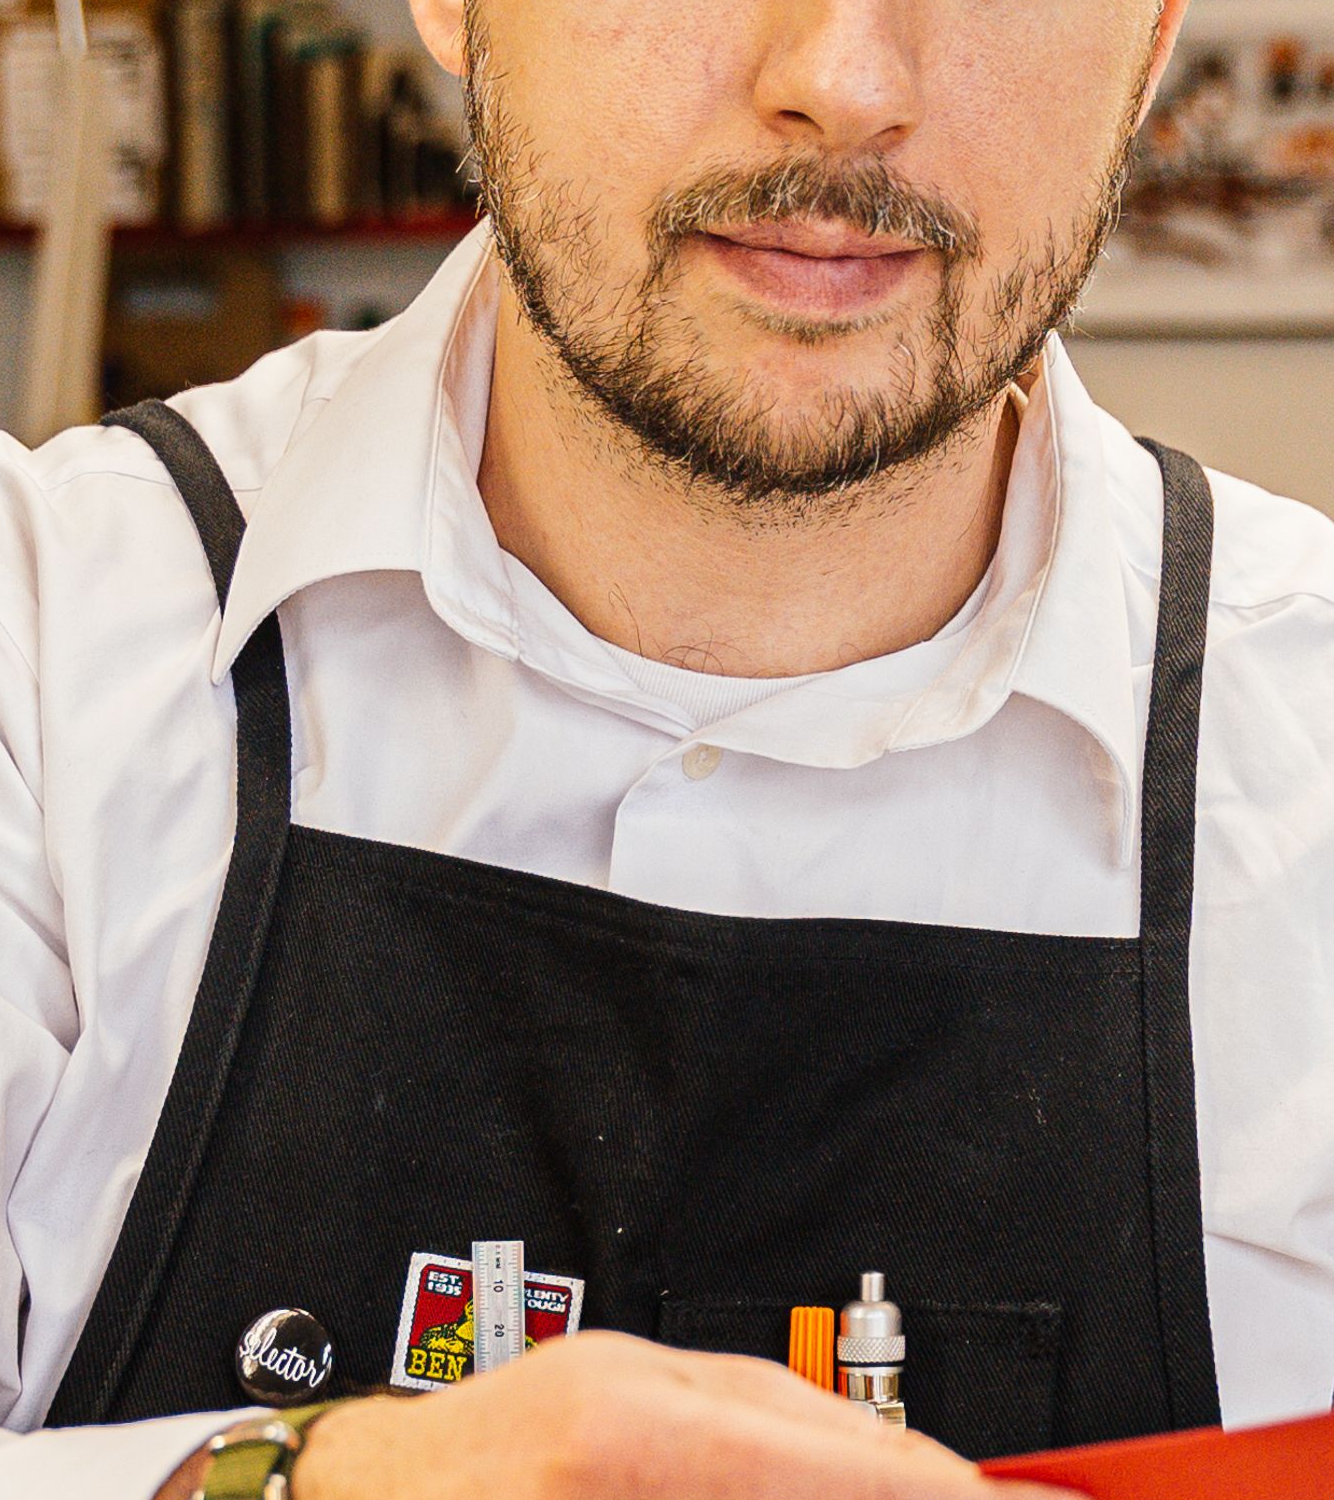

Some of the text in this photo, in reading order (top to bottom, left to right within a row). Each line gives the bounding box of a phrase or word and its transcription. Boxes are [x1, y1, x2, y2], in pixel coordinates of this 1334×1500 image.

[428, 1271, 462, 1286] EST.
[427, 1282, 462, 1296] 1935
[493, 1280, 504, 1292] 10
[525, 1289, 568, 1302] LENTY
[527, 1299, 567, 1312] OUGH
[493, 1323, 505, 1338] 20
[408, 1349, 467, 1381] BEN
